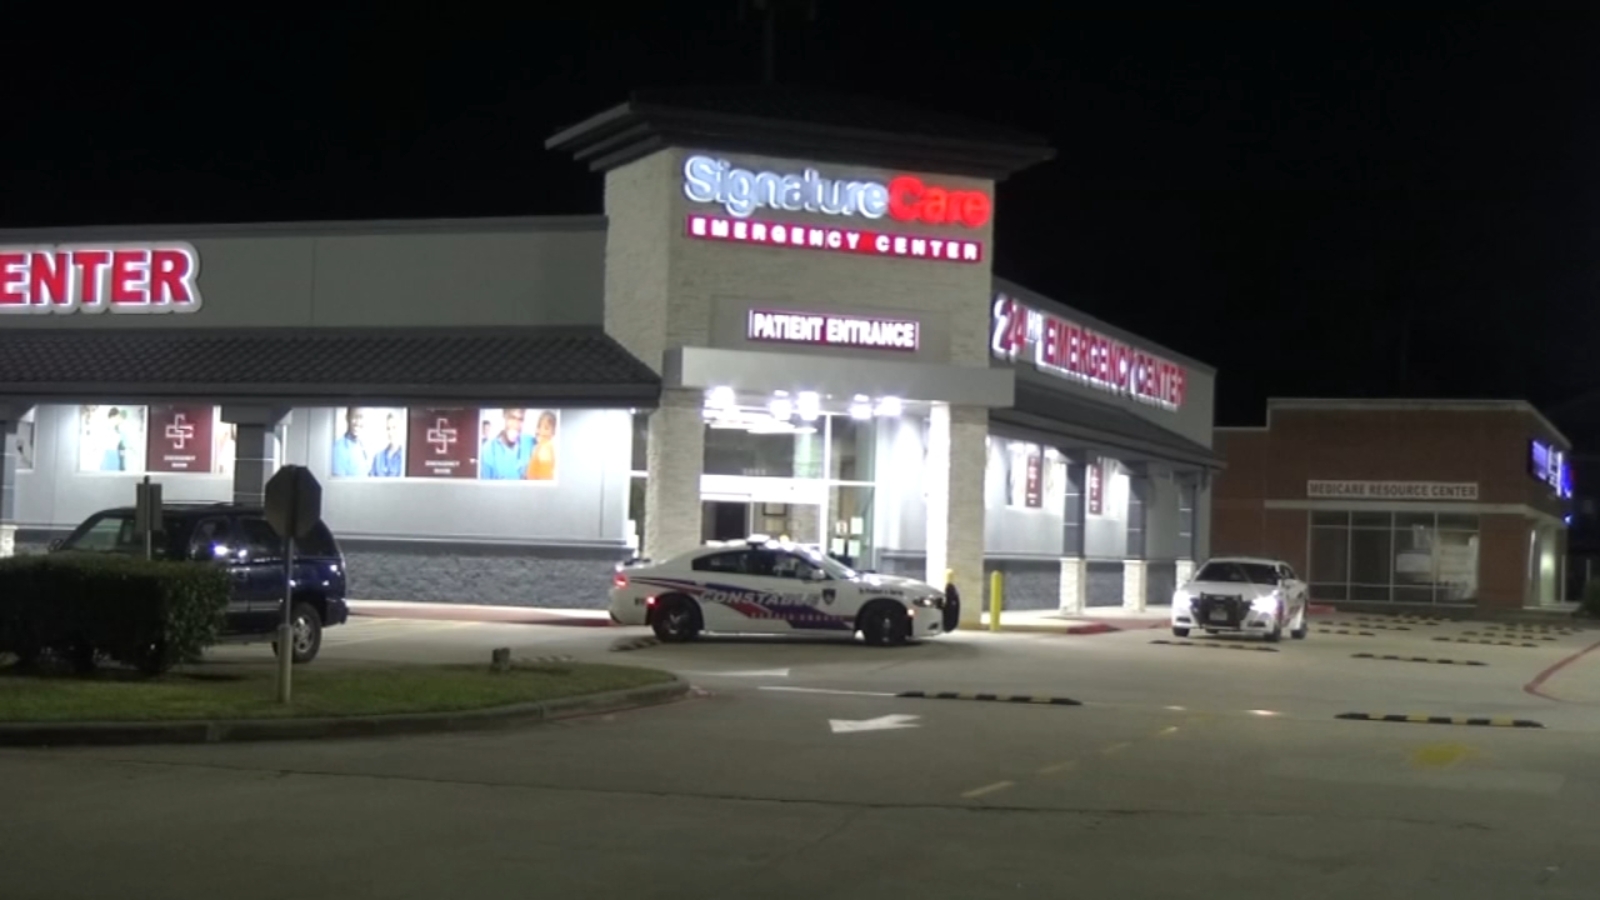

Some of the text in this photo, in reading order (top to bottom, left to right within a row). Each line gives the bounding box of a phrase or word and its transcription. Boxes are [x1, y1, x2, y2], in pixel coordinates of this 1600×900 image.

[691, 217, 978, 260] EMERGENCY CENTER
[754, 313, 915, 347] PATIENT ENTRANCE
[1045, 318, 1136, 388] EMERGENCY
[1135, 352, 1185, 405] CENTER
[1309, 483, 1476, 497] MEDICARE RESOURCE CENTER
